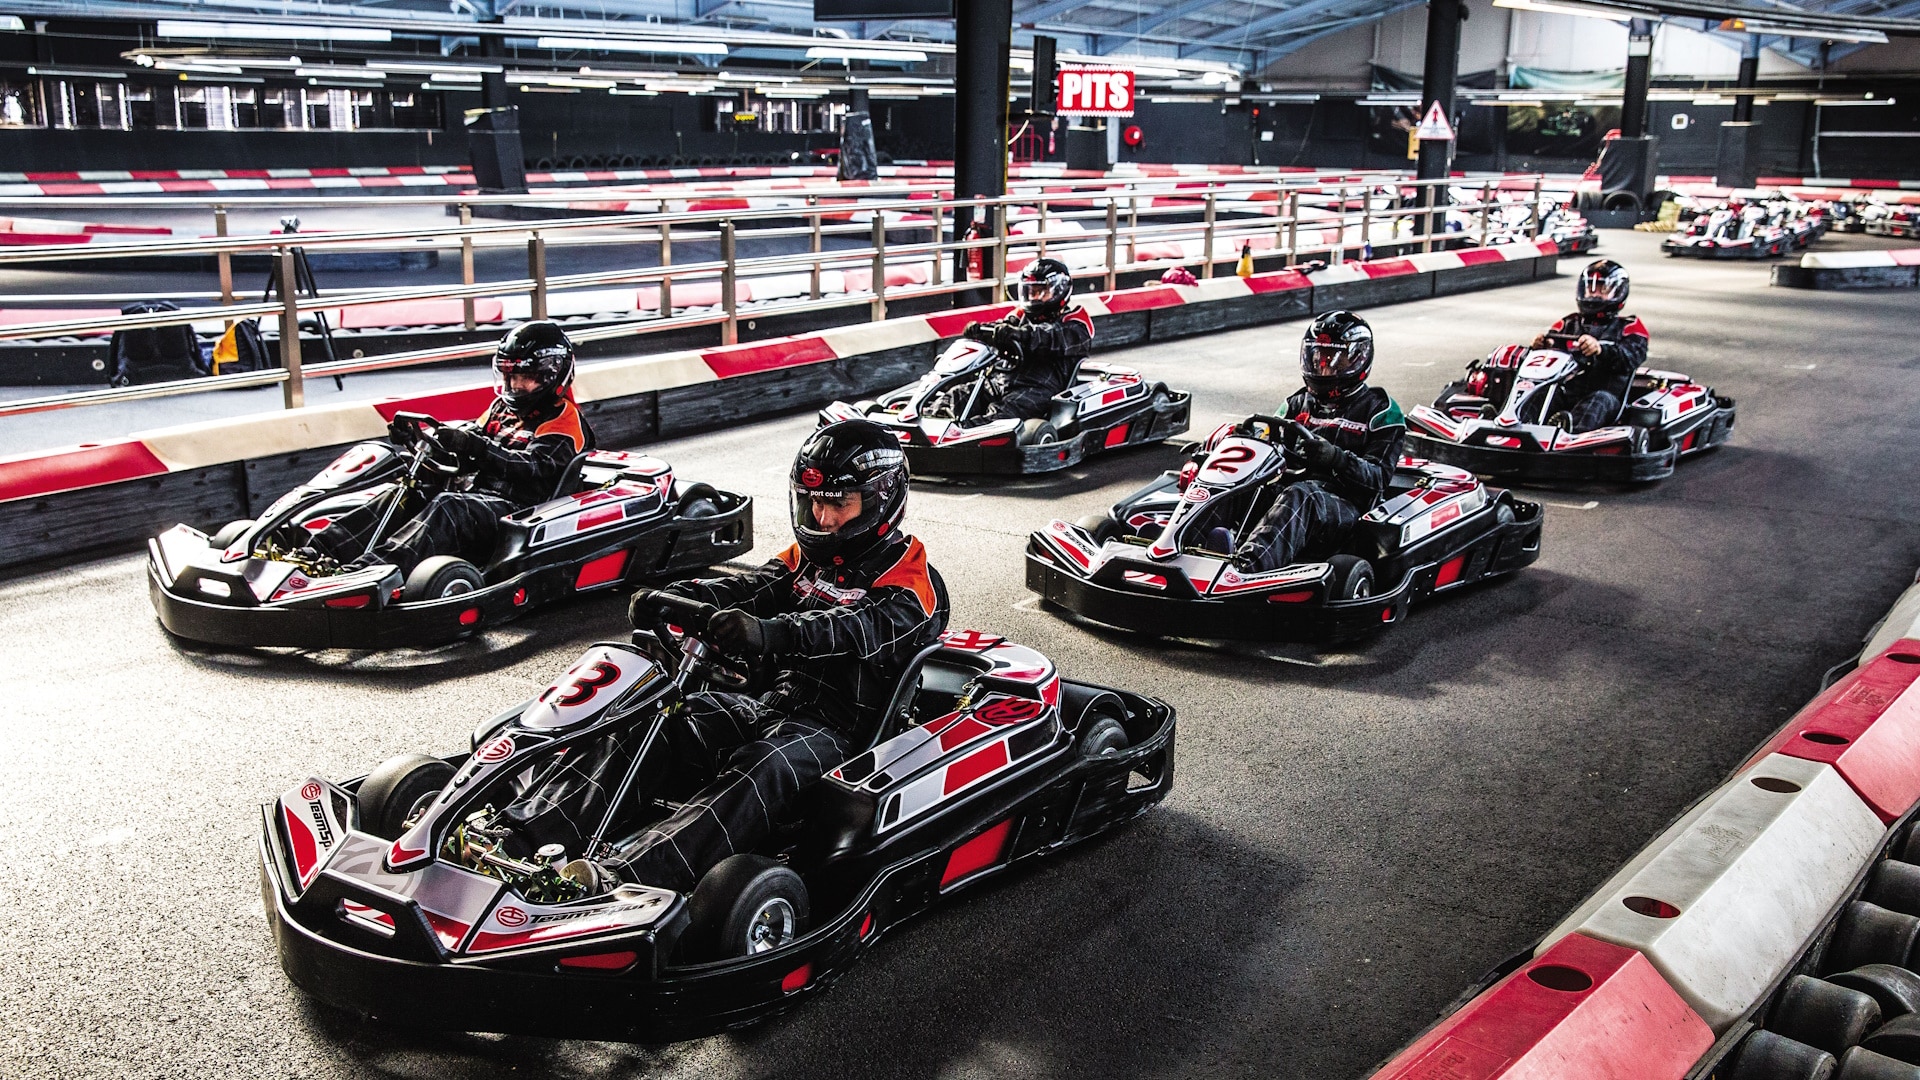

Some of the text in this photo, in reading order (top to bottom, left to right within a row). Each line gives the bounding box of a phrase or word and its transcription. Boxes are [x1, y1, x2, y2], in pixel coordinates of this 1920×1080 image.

[1062, 72, 1129, 109] PITS
[952, 346, 979, 360] 7
[1526, 355, 1559, 368] 21
[1206, 446, 1256, 474] 2
[309, 799, 335, 851] TeamSp
